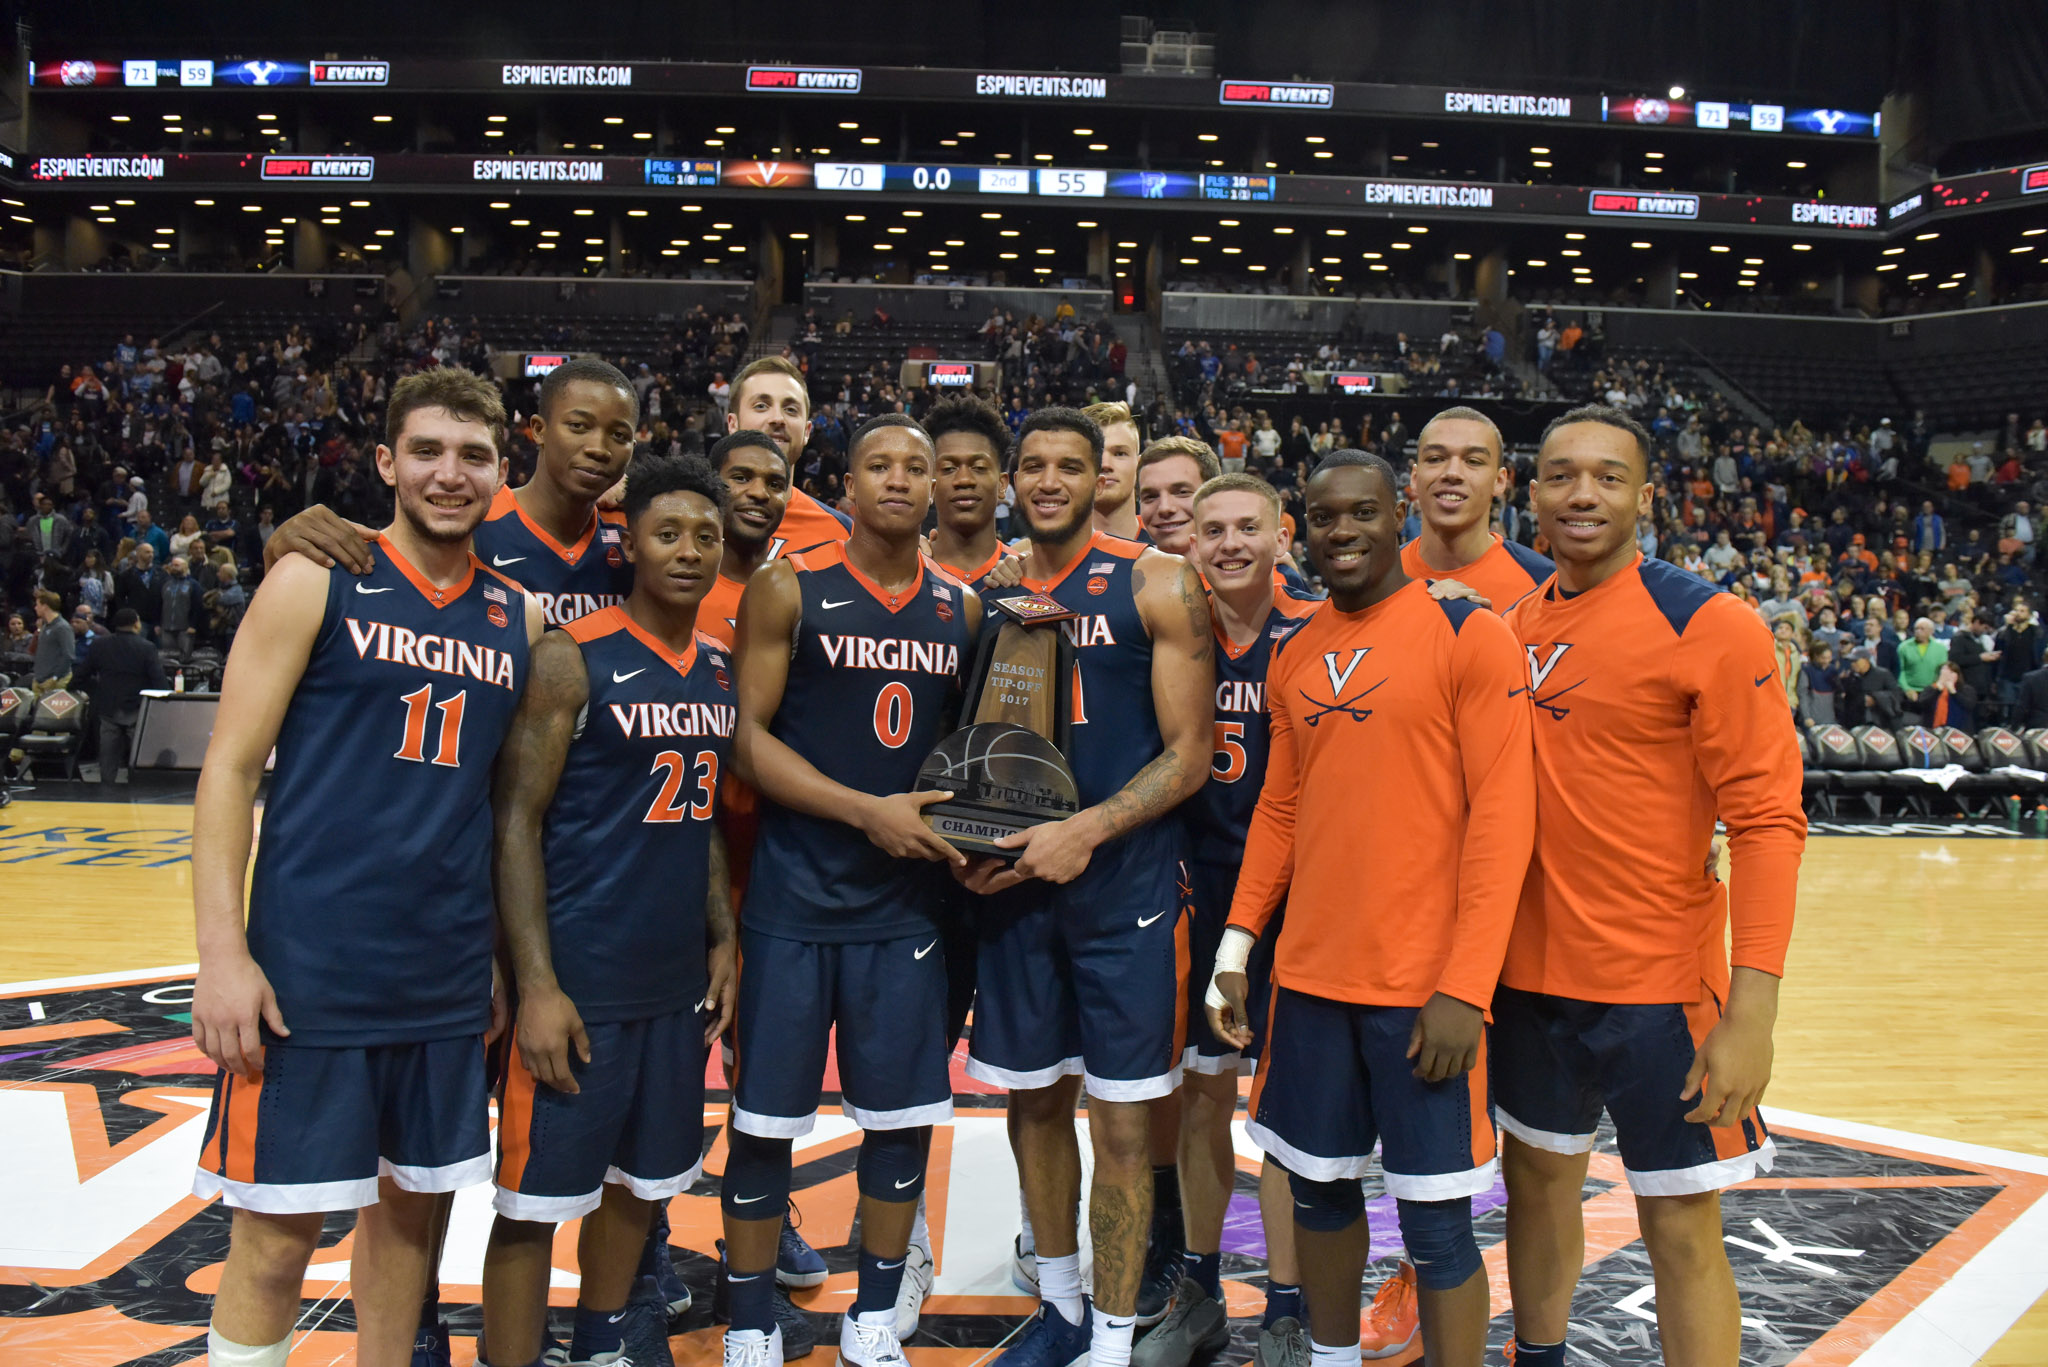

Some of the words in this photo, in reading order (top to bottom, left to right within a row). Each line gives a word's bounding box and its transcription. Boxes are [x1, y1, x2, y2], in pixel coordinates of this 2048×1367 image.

[132, 68, 149, 80] 71
[188, 68, 206, 80] 59
[327, 66, 386, 81] EVENTS
[502, 65, 632, 86] ESPNEVENTS.COM
[751, 71, 796, 86] ESPN
[797, 73, 857, 89] EVENTS
[976, 75, 1106, 98] ESPNEVENTS.COM
[1225, 85, 1270, 101] ESPN
[1271, 87, 1330, 104] EVENTS
[1445, 92, 1571, 117] ESPNEVENTS.COM
[1705, 109, 1721, 122] 71
[1759, 112, 1776, 126] 59
[39, 157, 164, 177] ESPNEVENTS.COM
[266, 161, 309, 175] ESPN
[311, 161, 370, 176] EVENTS
[473, 160, 603, 182] ESPNEVENTS.COM
[681, 161, 690, 173] 9
[835, 167, 864, 187] 70
[913, 167, 951, 191] 0.0
[991, 173, 1017, 188] 2nd
[1058, 174, 1085, 193] 55
[1232, 176, 1248, 188] 10
[1365, 183, 1493, 208] ESPNEVENTS.COM
[1594, 195, 1637, 211] ESPN
[1638, 198, 1695, 214] EVENTS
[931, 374, 972, 384] EVENTS
[1015, 601, 1055, 611] NIT
[344, 617, 514, 692] VIRGINIA
[818, 634, 958, 676] VIRGINIA
[993, 662, 1045, 678] SEASON
[1322, 647, 1375, 700] V
[991, 676, 1043, 693] TIP-OFF
[1000, 693, 1029, 706] 2017
[609, 702, 737, 741] VIRGINIA
[873, 681, 914, 749] 0
[393, 683, 466, 768] 11
[1211, 720, 1247, 784] 5
[642, 750, 718, 823] 23
